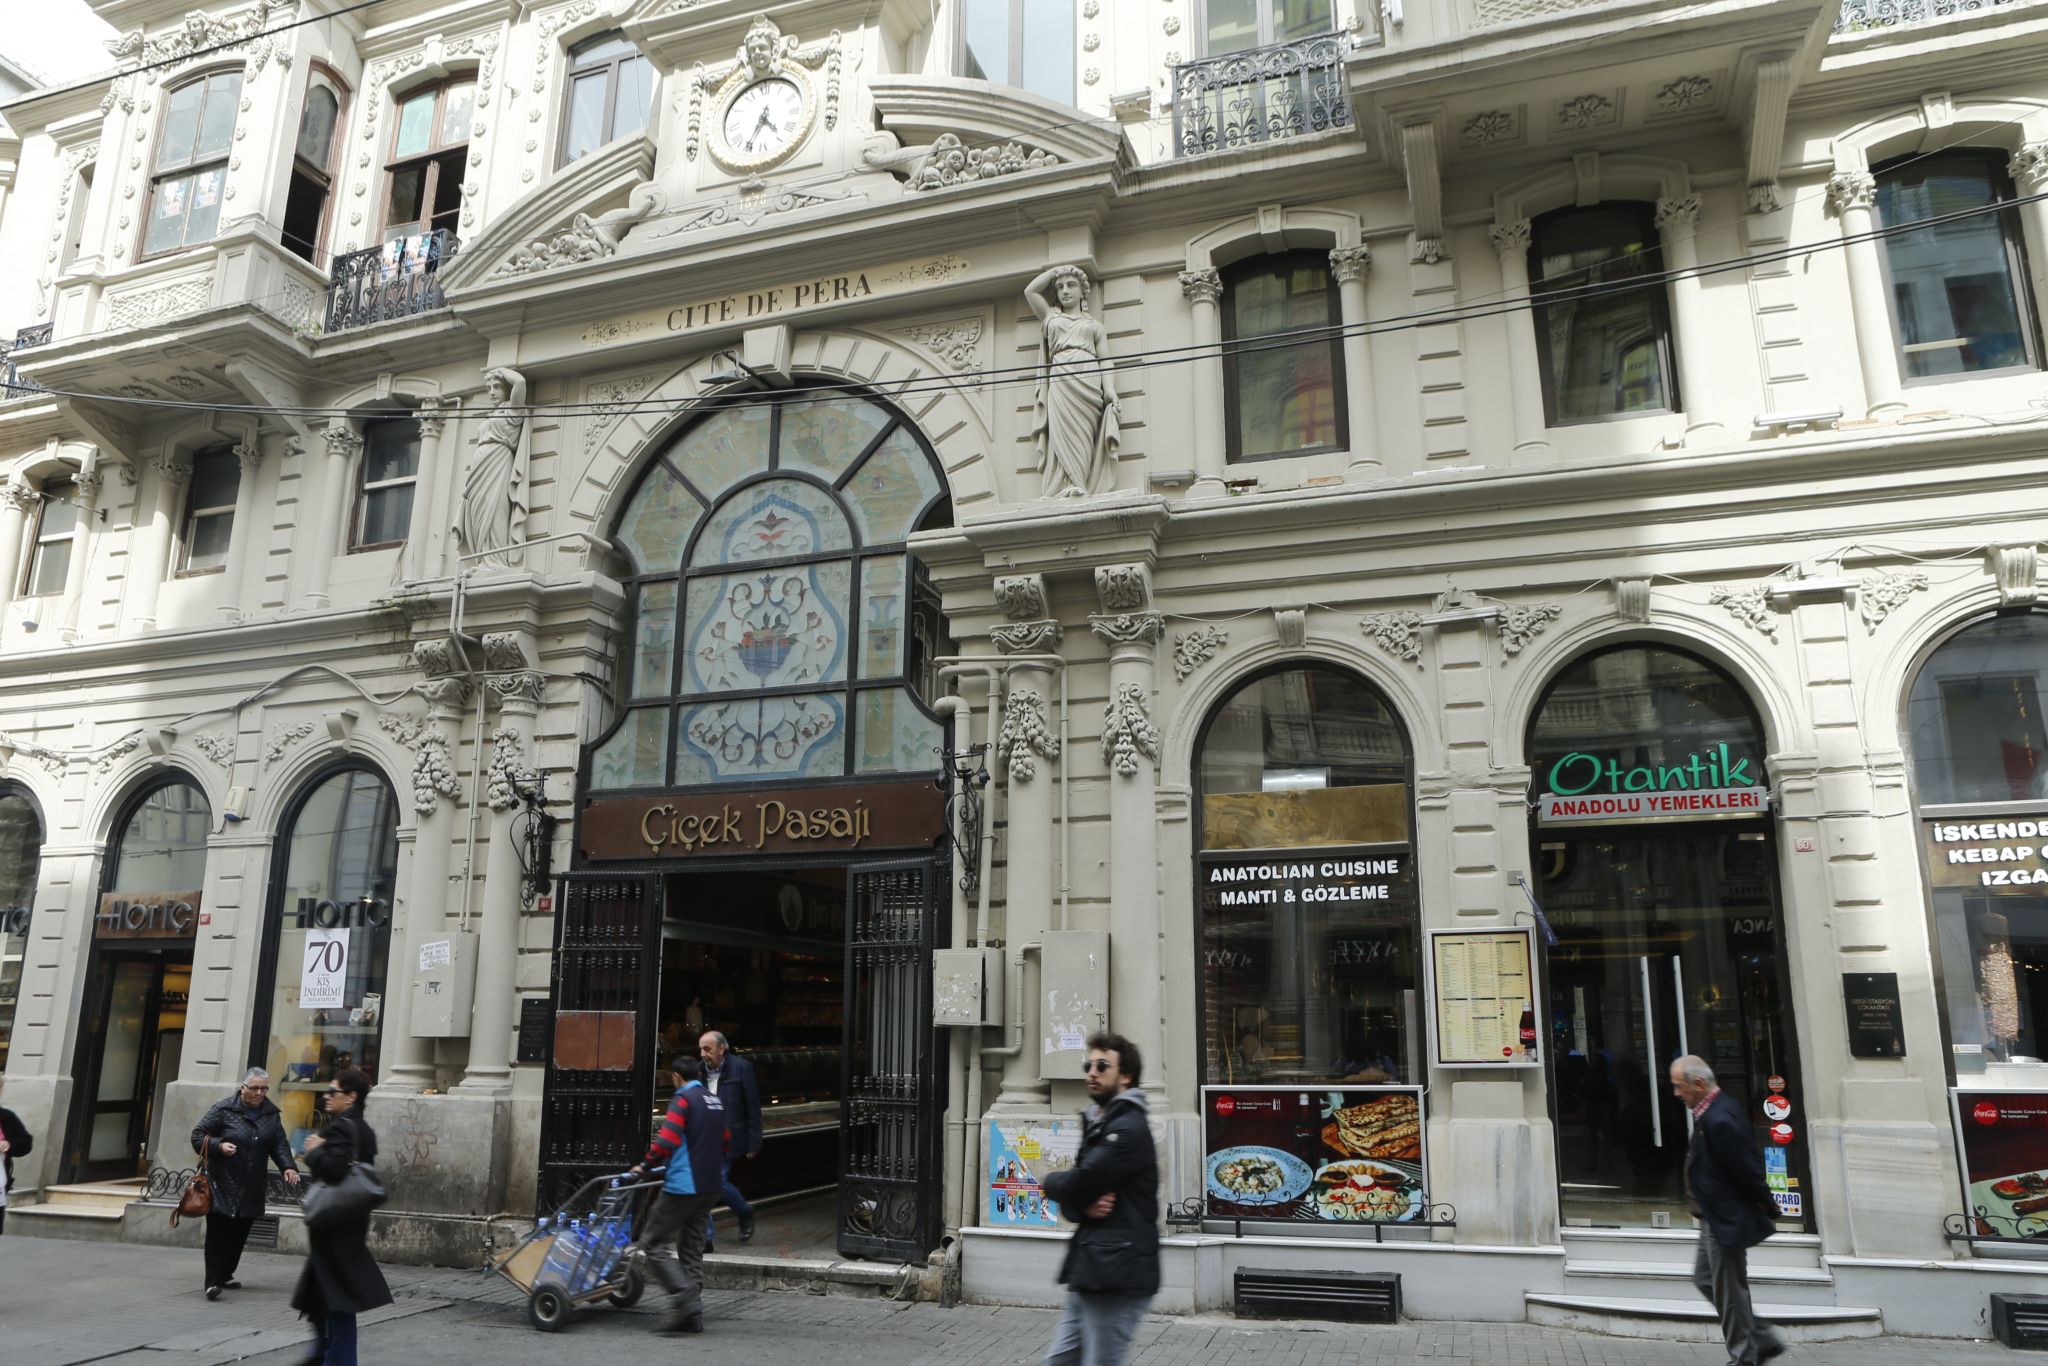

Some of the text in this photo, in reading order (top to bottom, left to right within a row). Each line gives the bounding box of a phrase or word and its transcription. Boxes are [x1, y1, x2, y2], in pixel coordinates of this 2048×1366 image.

[667, 273, 873, 332] CITÉ DE PÉRA
[1549, 741, 1754, 795] Otantik
[1551, 798, 1641, 816] ANADOLU
[641, 799, 871, 854] Çiçek Pasajı
[1948, 846, 2034, 864] KEBAP
[1211, 860, 1399, 882] ANATOLIAN CUISINE
[1982, 868, 2048, 886] IZGA
[1221, 884, 1389, 906] MANTI & GÖZLEME
[308, 940, 345, 974] 70
